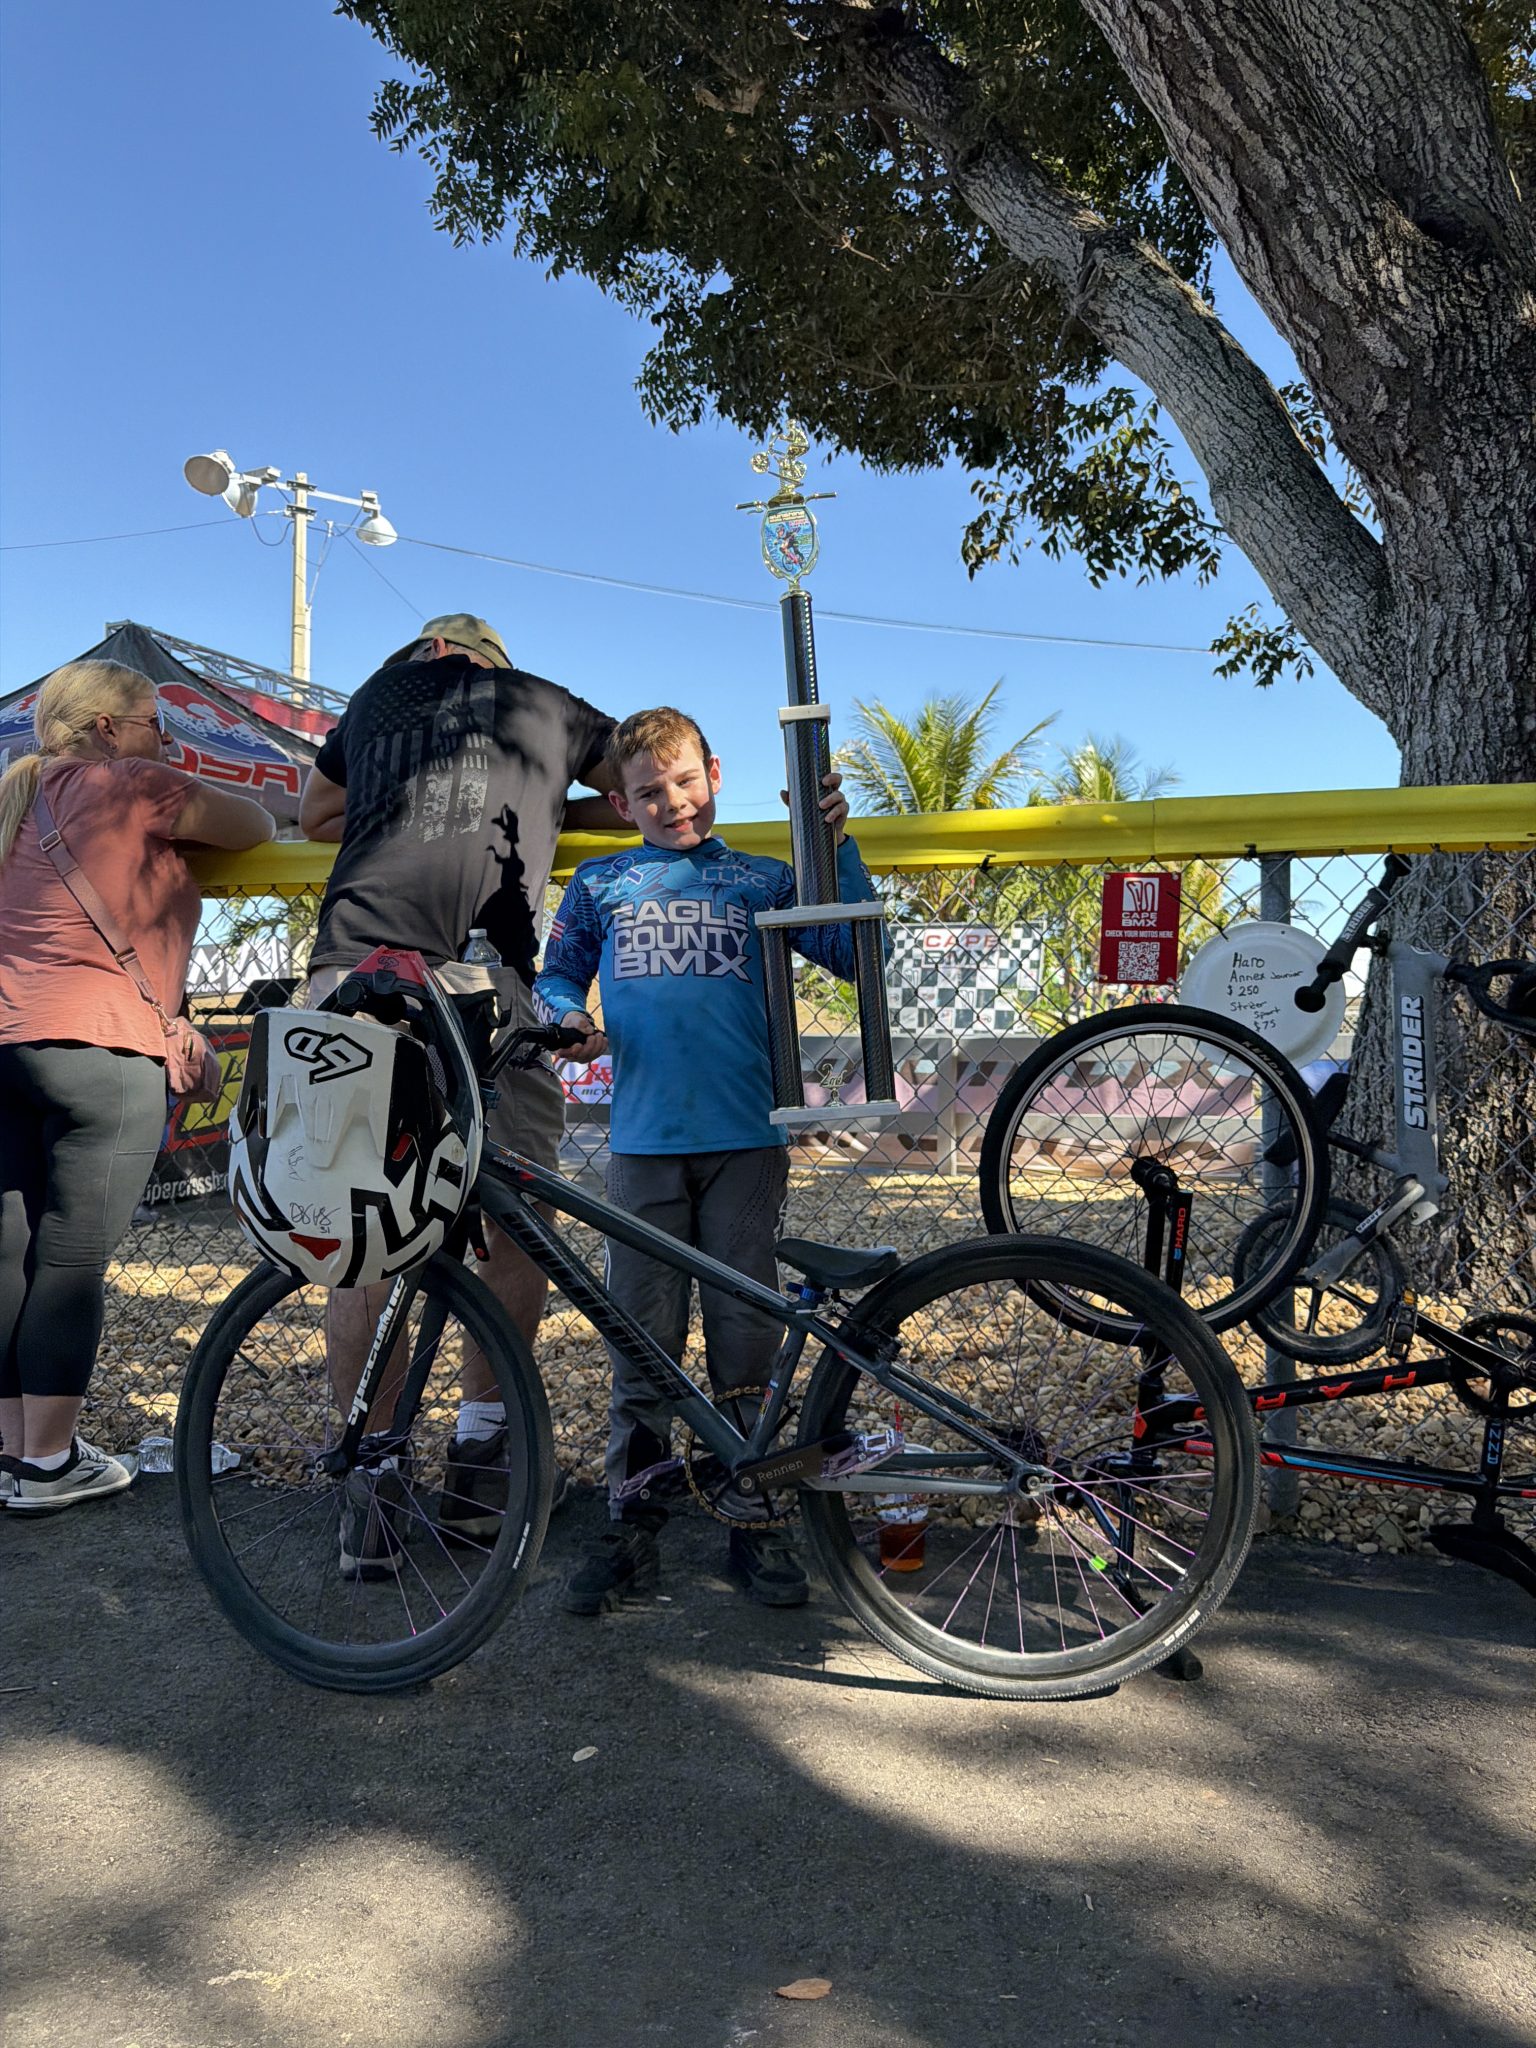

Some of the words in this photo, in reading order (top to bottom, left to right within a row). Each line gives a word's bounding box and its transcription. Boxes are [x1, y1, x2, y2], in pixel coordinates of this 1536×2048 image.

[613, 900, 749, 931] EAGLE
[1121, 919, 1157, 927] BMX
[1342, 900, 1375, 942] STRIDER
[613, 926, 749, 956] COUNTY
[925, 935, 999, 948] CAPE
[1139, 930, 1158, 938] MOTOS
[613, 950, 752, 984] BMX
[925, 950, 997, 966] BMX
[1232, 952, 1265, 968] Haro
[1230, 969, 1265, 982] Annex
[1241, 1040, 1285, 1077] KENDA
[1401, 995, 1428, 1131] STRIDER
[1174, 1207, 1187, 1249] HARO
[756, 1459, 804, 1483] Rennen
